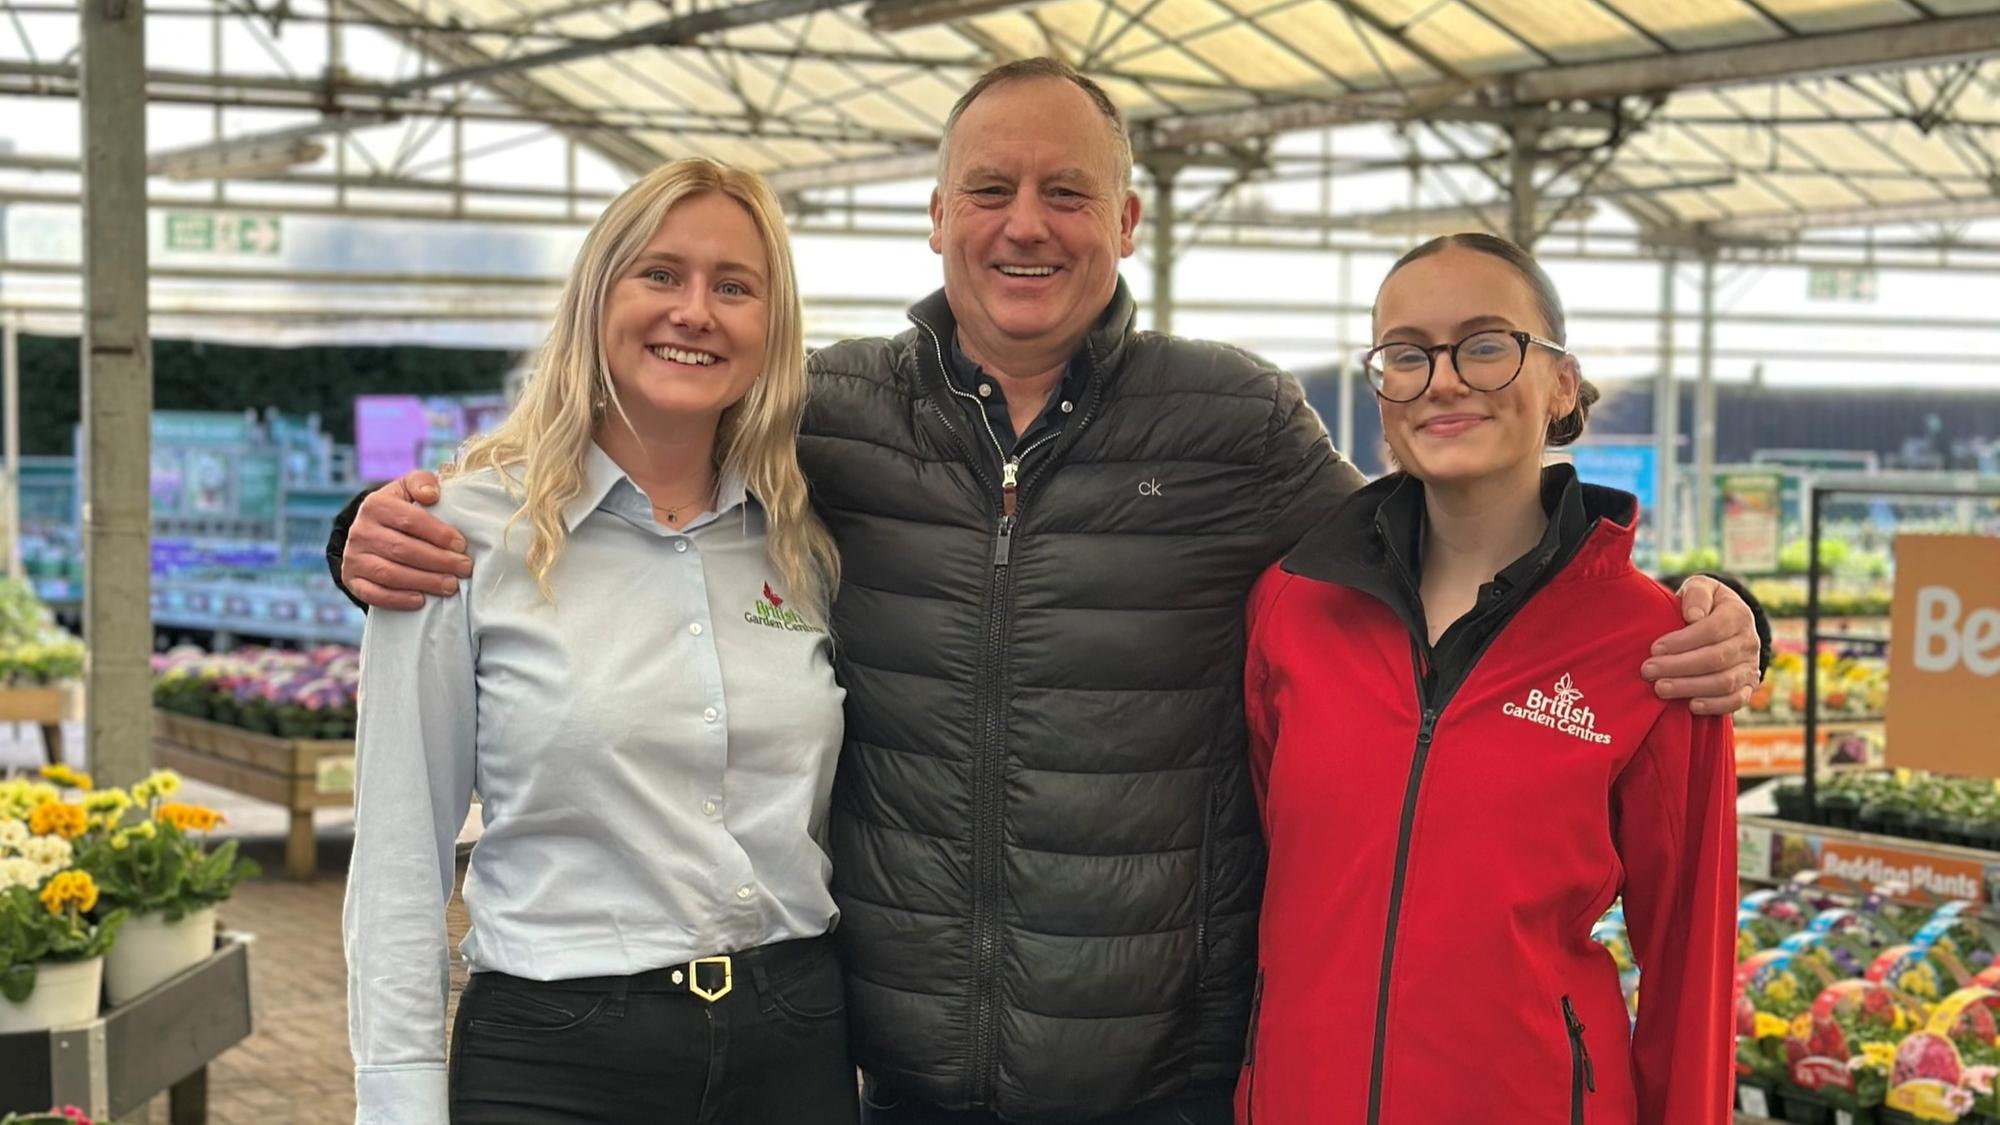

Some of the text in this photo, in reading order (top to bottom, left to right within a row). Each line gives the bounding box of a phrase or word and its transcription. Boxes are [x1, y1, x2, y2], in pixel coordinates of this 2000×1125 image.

[1138, 477, 1162, 496] ck
[744, 611, 784, 631] Garden
[755, 599, 804, 624] British
[1914, 585, 2000, 676] Be
[1502, 702, 1612, 744] Garden Centres
[1526, 688, 1595, 728] British
[1824, 852, 1977, 898] Bedding Plants
